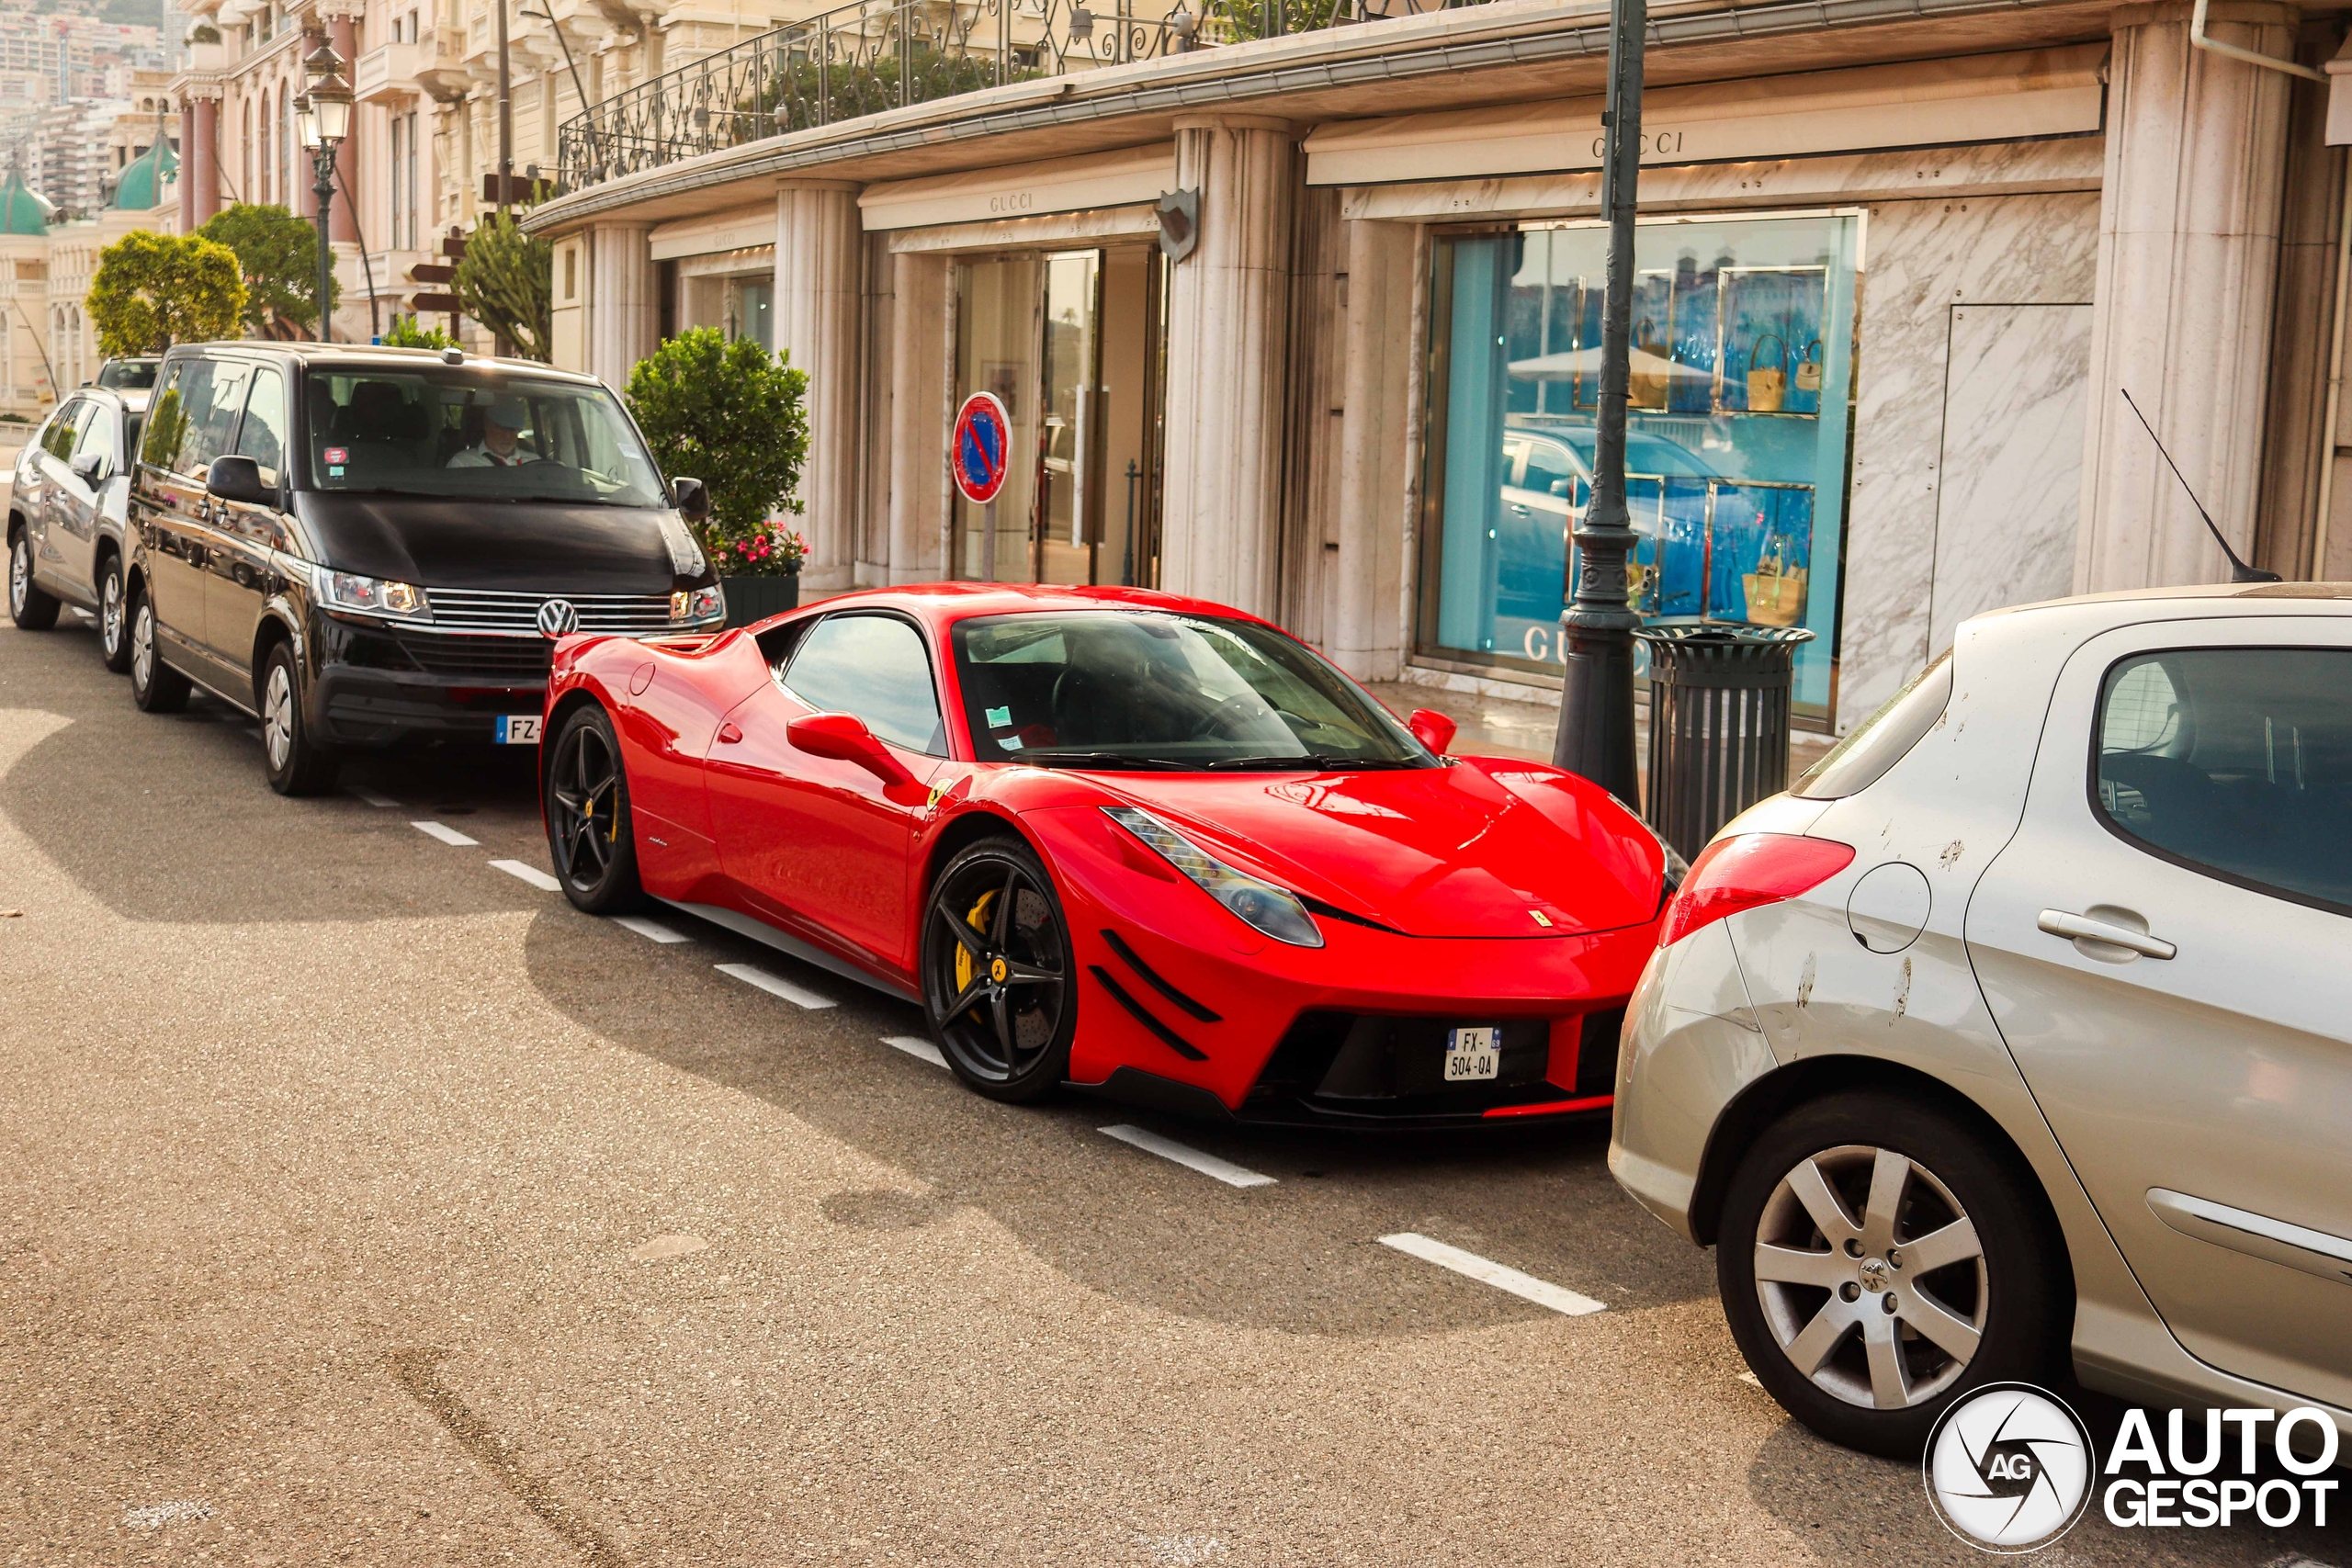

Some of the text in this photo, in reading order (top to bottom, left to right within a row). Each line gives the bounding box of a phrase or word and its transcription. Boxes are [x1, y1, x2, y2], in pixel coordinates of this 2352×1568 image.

[1592, 132, 1682, 158] GCCI
[990, 193, 1032, 212] GUCCI
[1452, 1055, 1491, 1077] 504-QA
